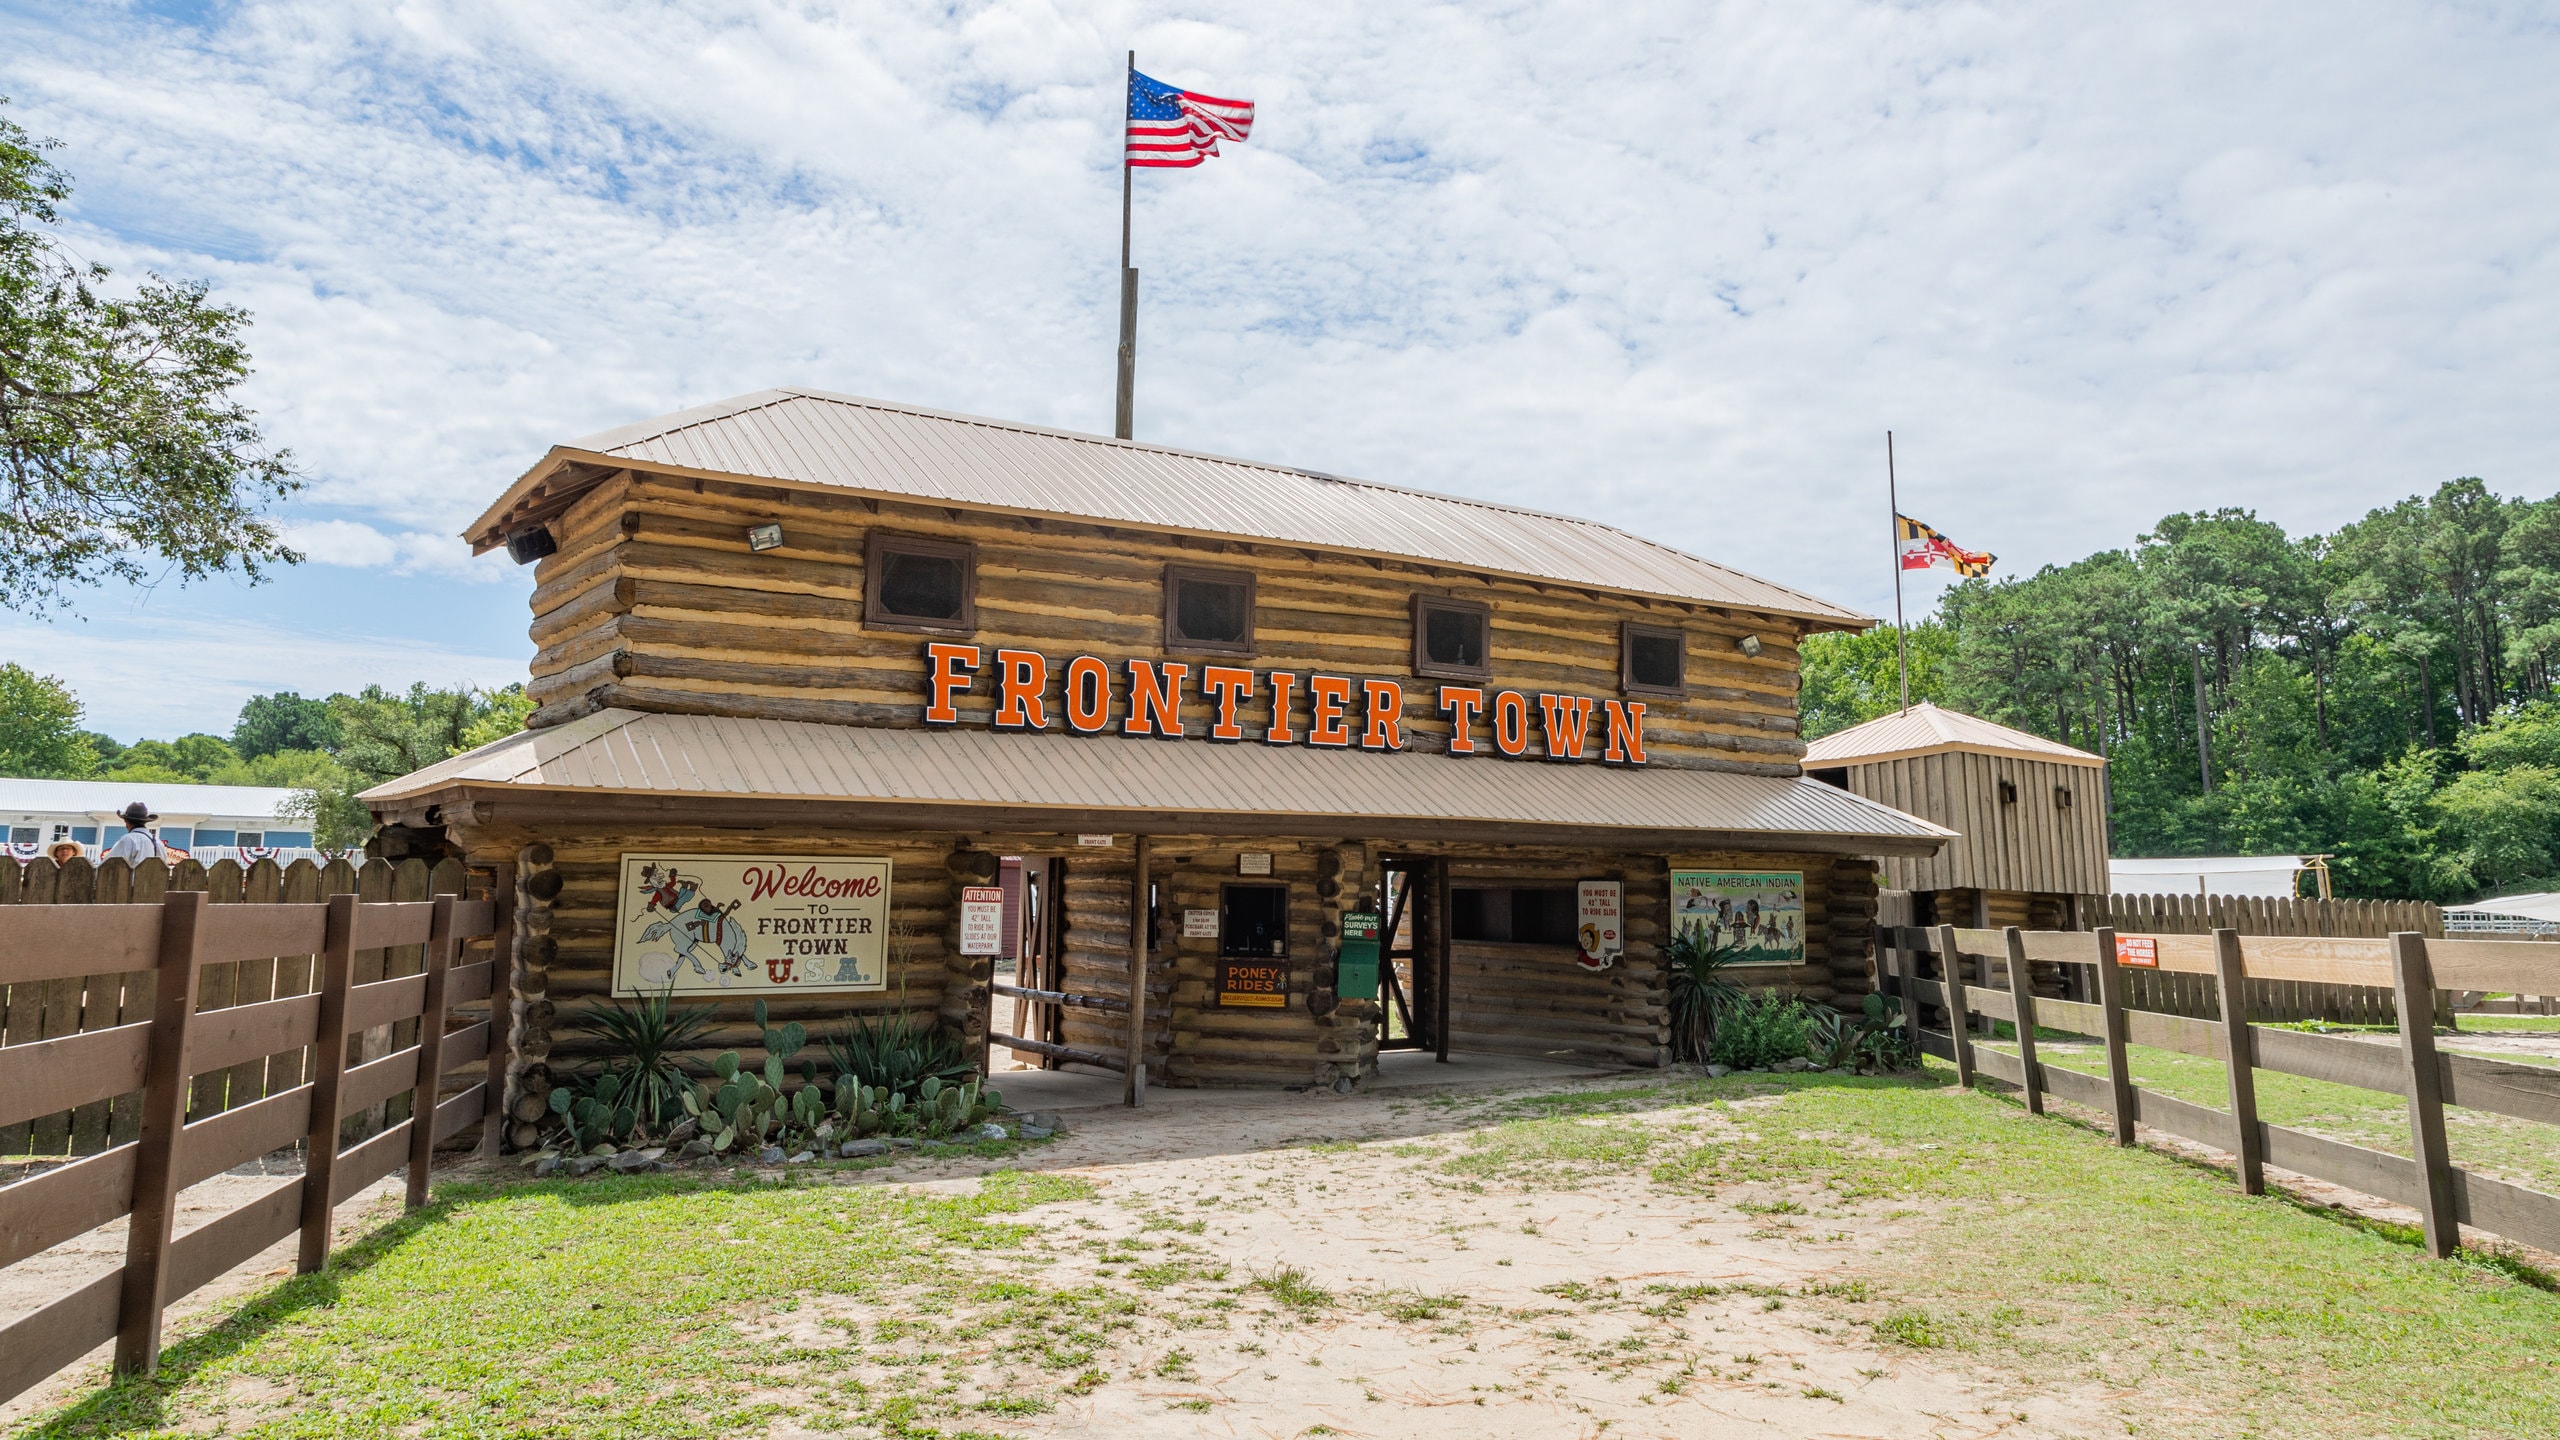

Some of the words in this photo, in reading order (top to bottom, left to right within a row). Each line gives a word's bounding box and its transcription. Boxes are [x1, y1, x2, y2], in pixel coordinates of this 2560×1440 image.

[923, 642, 1405, 751] FRONTIER
[1435, 685, 1647, 765] TOWN
[742, 864, 881, 901] Welcome
[1678, 876, 1711, 888] NATIVE
[1716, 877, 1762, 888] AMERICAN
[965, 890, 1001, 902] ATTENTION
[808, 904, 829, 915] TO
[757, 917, 873, 935] FRONTIER
[783, 938, 848, 956] TOWN
[2126, 938, 2132, 947] DO
[2133, 939, 2141, 948] NOT
[2142, 939, 2154, 948] FEED
[2127, 948, 2136, 956] THE
[766, 957, 870, 984] U.S.A.
[1228, 966, 1278, 980] PONEY
[1227, 980, 1274, 992] RIDES
